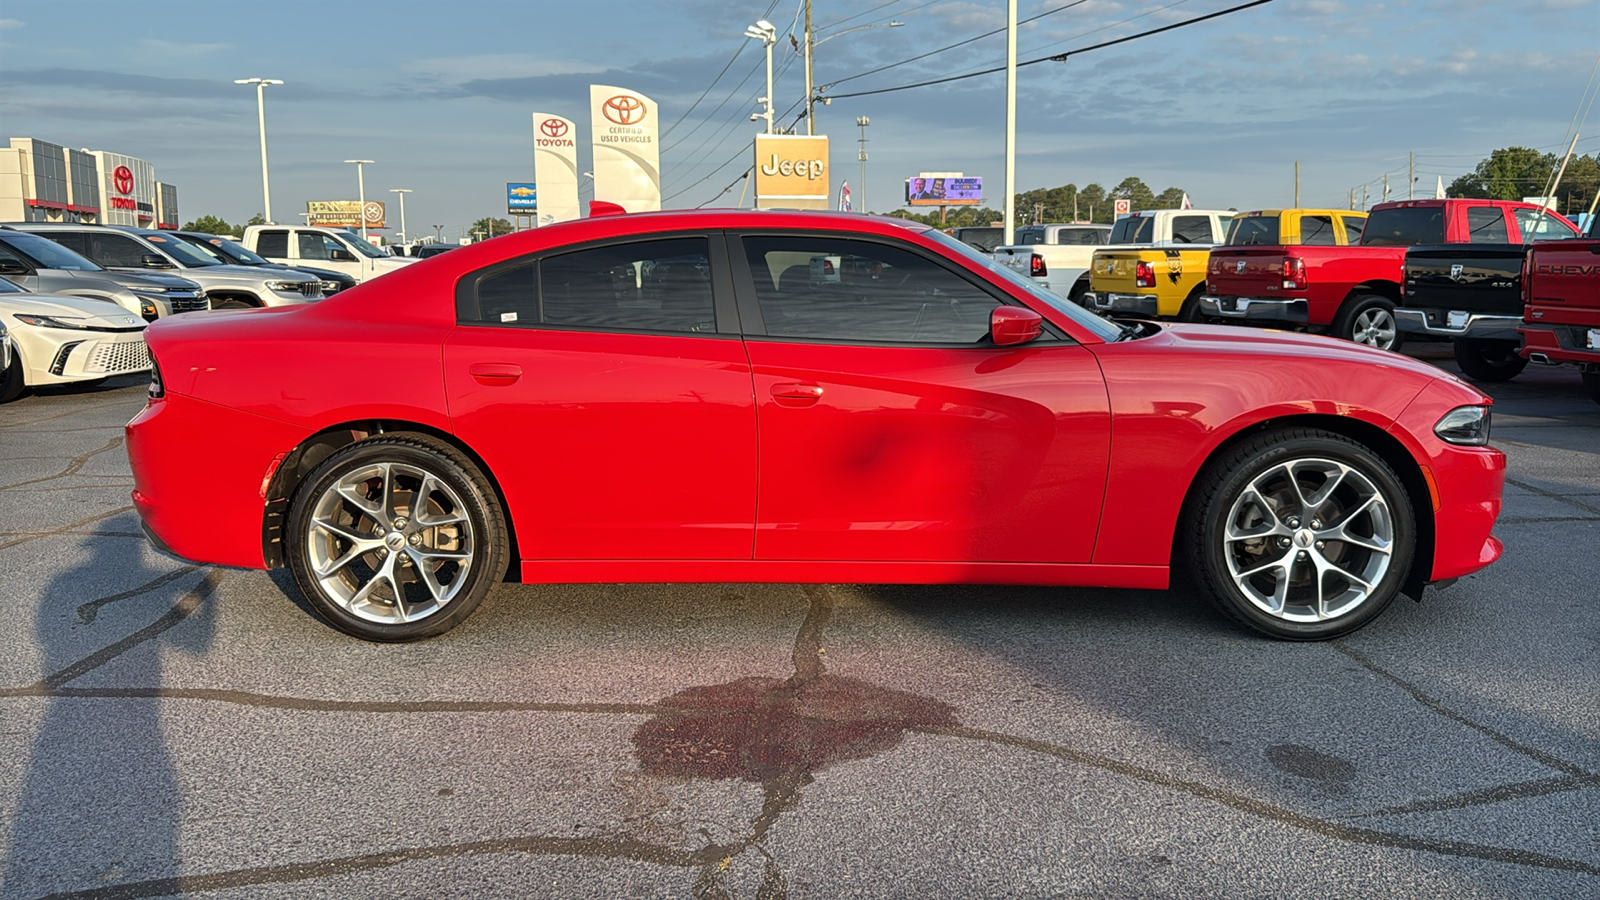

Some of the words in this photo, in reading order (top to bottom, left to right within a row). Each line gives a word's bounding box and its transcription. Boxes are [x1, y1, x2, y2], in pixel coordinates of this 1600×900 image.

[609, 127, 642, 135] CERTIFIED
[536, 139, 574, 148] TOYOTA
[601, 135, 618, 143] USED
[620, 136, 652, 144] VEHICLES
[762, 153, 824, 181] Jeep
[110, 196, 137, 210] TOYOTA
